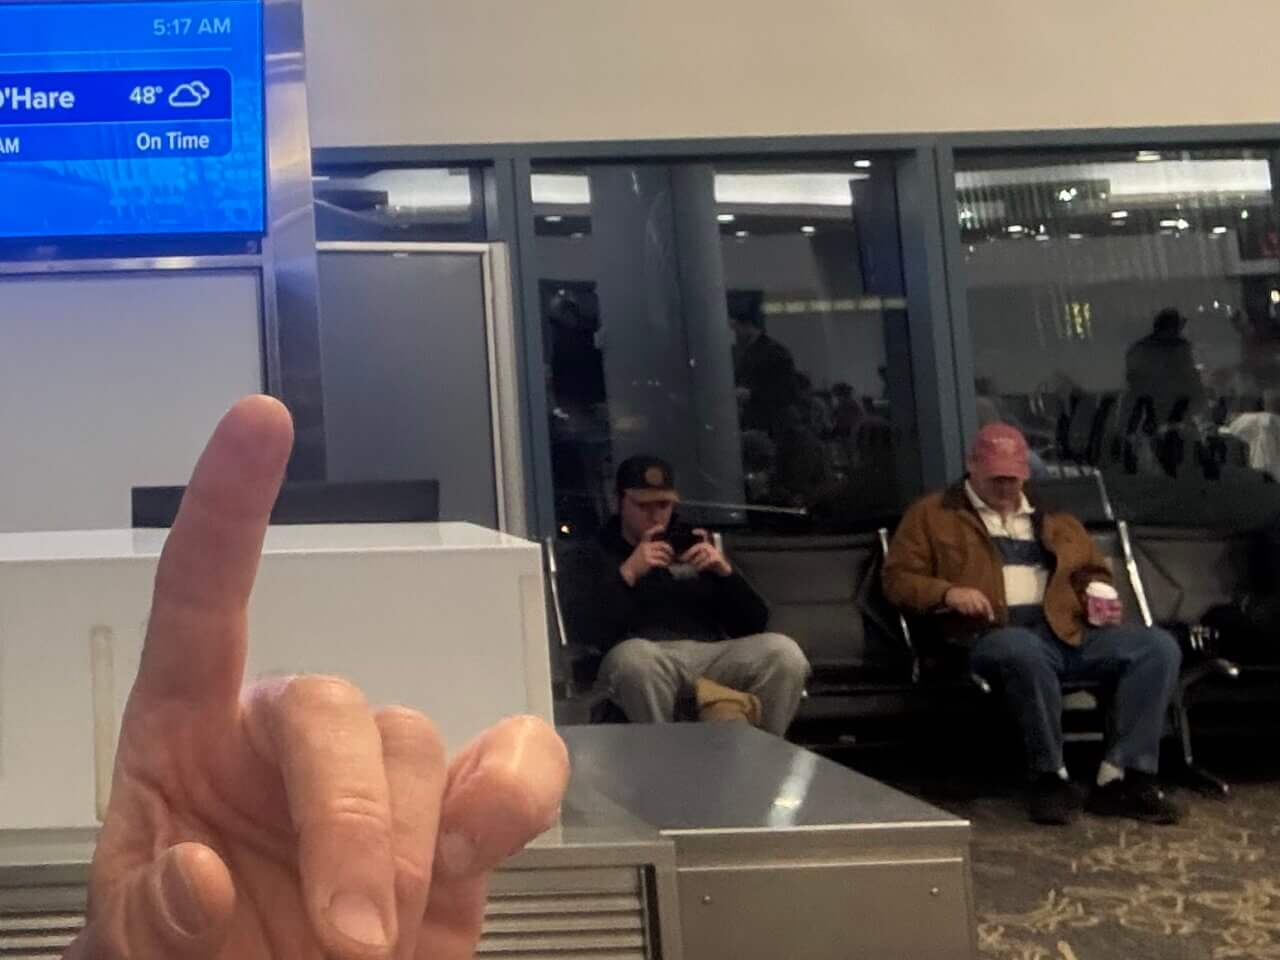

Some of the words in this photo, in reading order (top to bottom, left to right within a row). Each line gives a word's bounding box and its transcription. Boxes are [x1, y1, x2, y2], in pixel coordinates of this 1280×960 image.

[153, 18, 192, 36] 5:17
[197, 17, 231, 35] AM
[129, 86, 163, 104] 48°
[136, 132, 161, 150] On
[166, 131, 210, 149] Time
